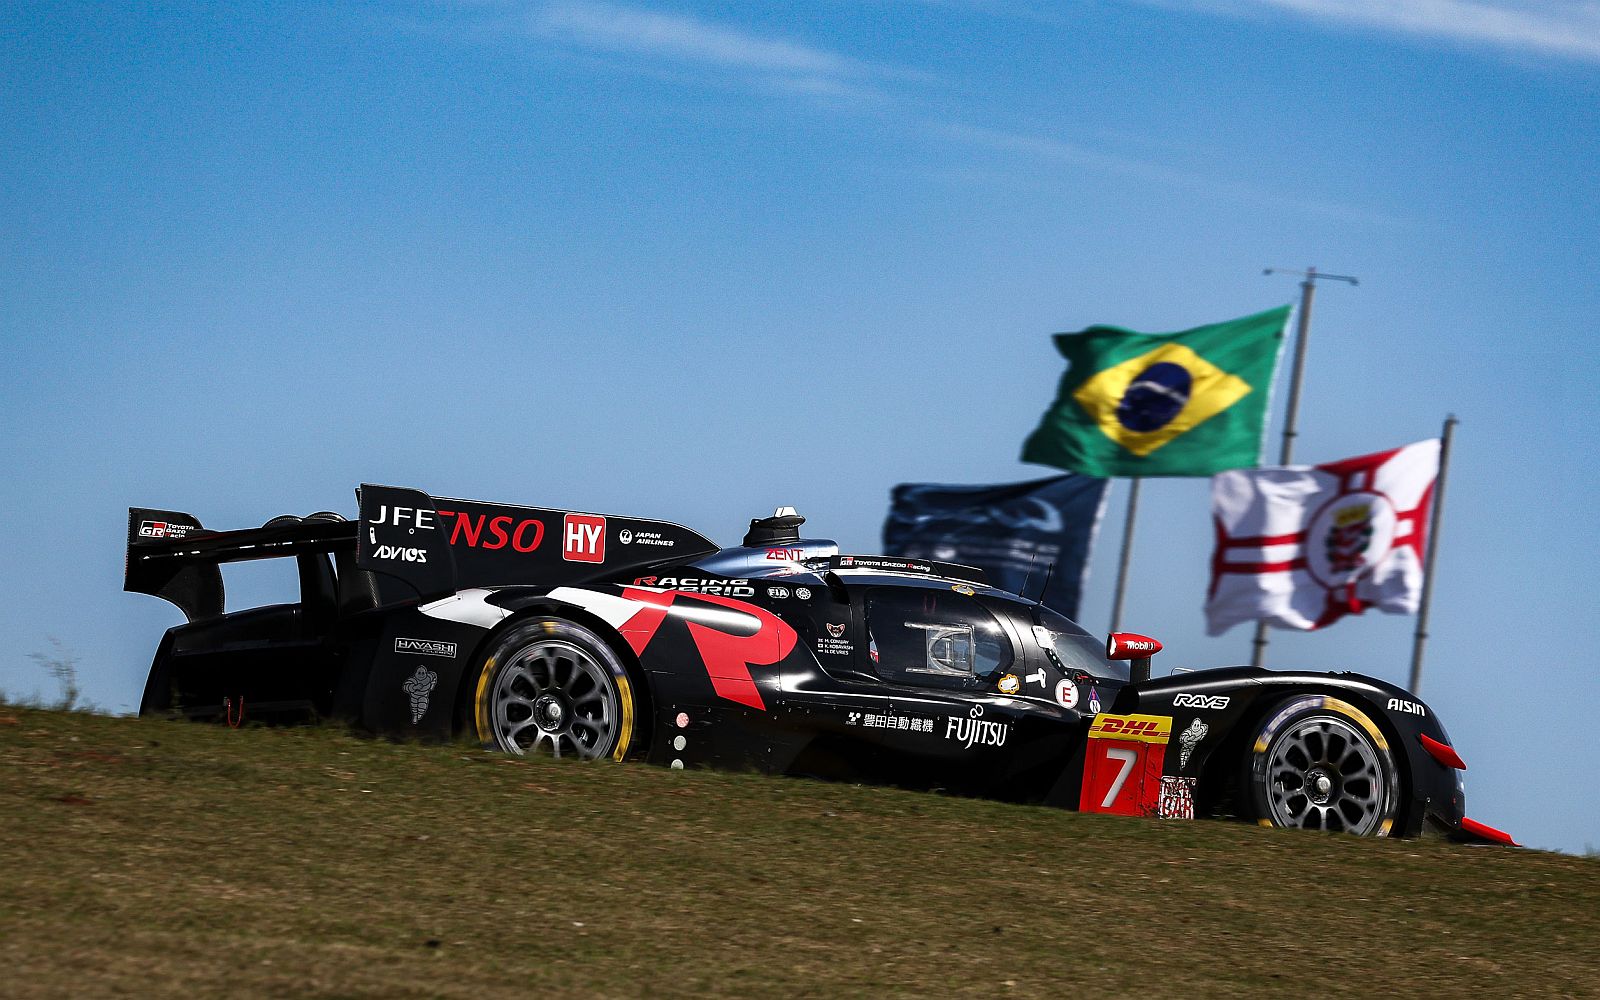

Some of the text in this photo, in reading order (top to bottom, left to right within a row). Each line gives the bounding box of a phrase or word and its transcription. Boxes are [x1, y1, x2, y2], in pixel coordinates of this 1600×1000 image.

[369, 505, 435, 530] JFE
[140, 525, 164, 537] GR
[437, 510, 545, 553] NSO
[566, 522, 603, 555] HY
[765, 548, 803, 561] ZENT
[907, 563, 930, 572] Racing
[633, 576, 749, 586] RACING
[676, 586, 755, 597] BRID
[768, 588, 788, 597] FIA
[398, 640, 454, 653] HAYASHI
[1125, 641, 1149, 650] Mobil
[1062, 687, 1071, 703] E
[1173, 693, 1230, 709] RAYS
[1387, 698, 1425, 717] AISIN
[945, 716, 1008, 749] FUJITSU
[1100, 718, 1161, 733] DHL
[1101, 748, 1138, 808] 7
